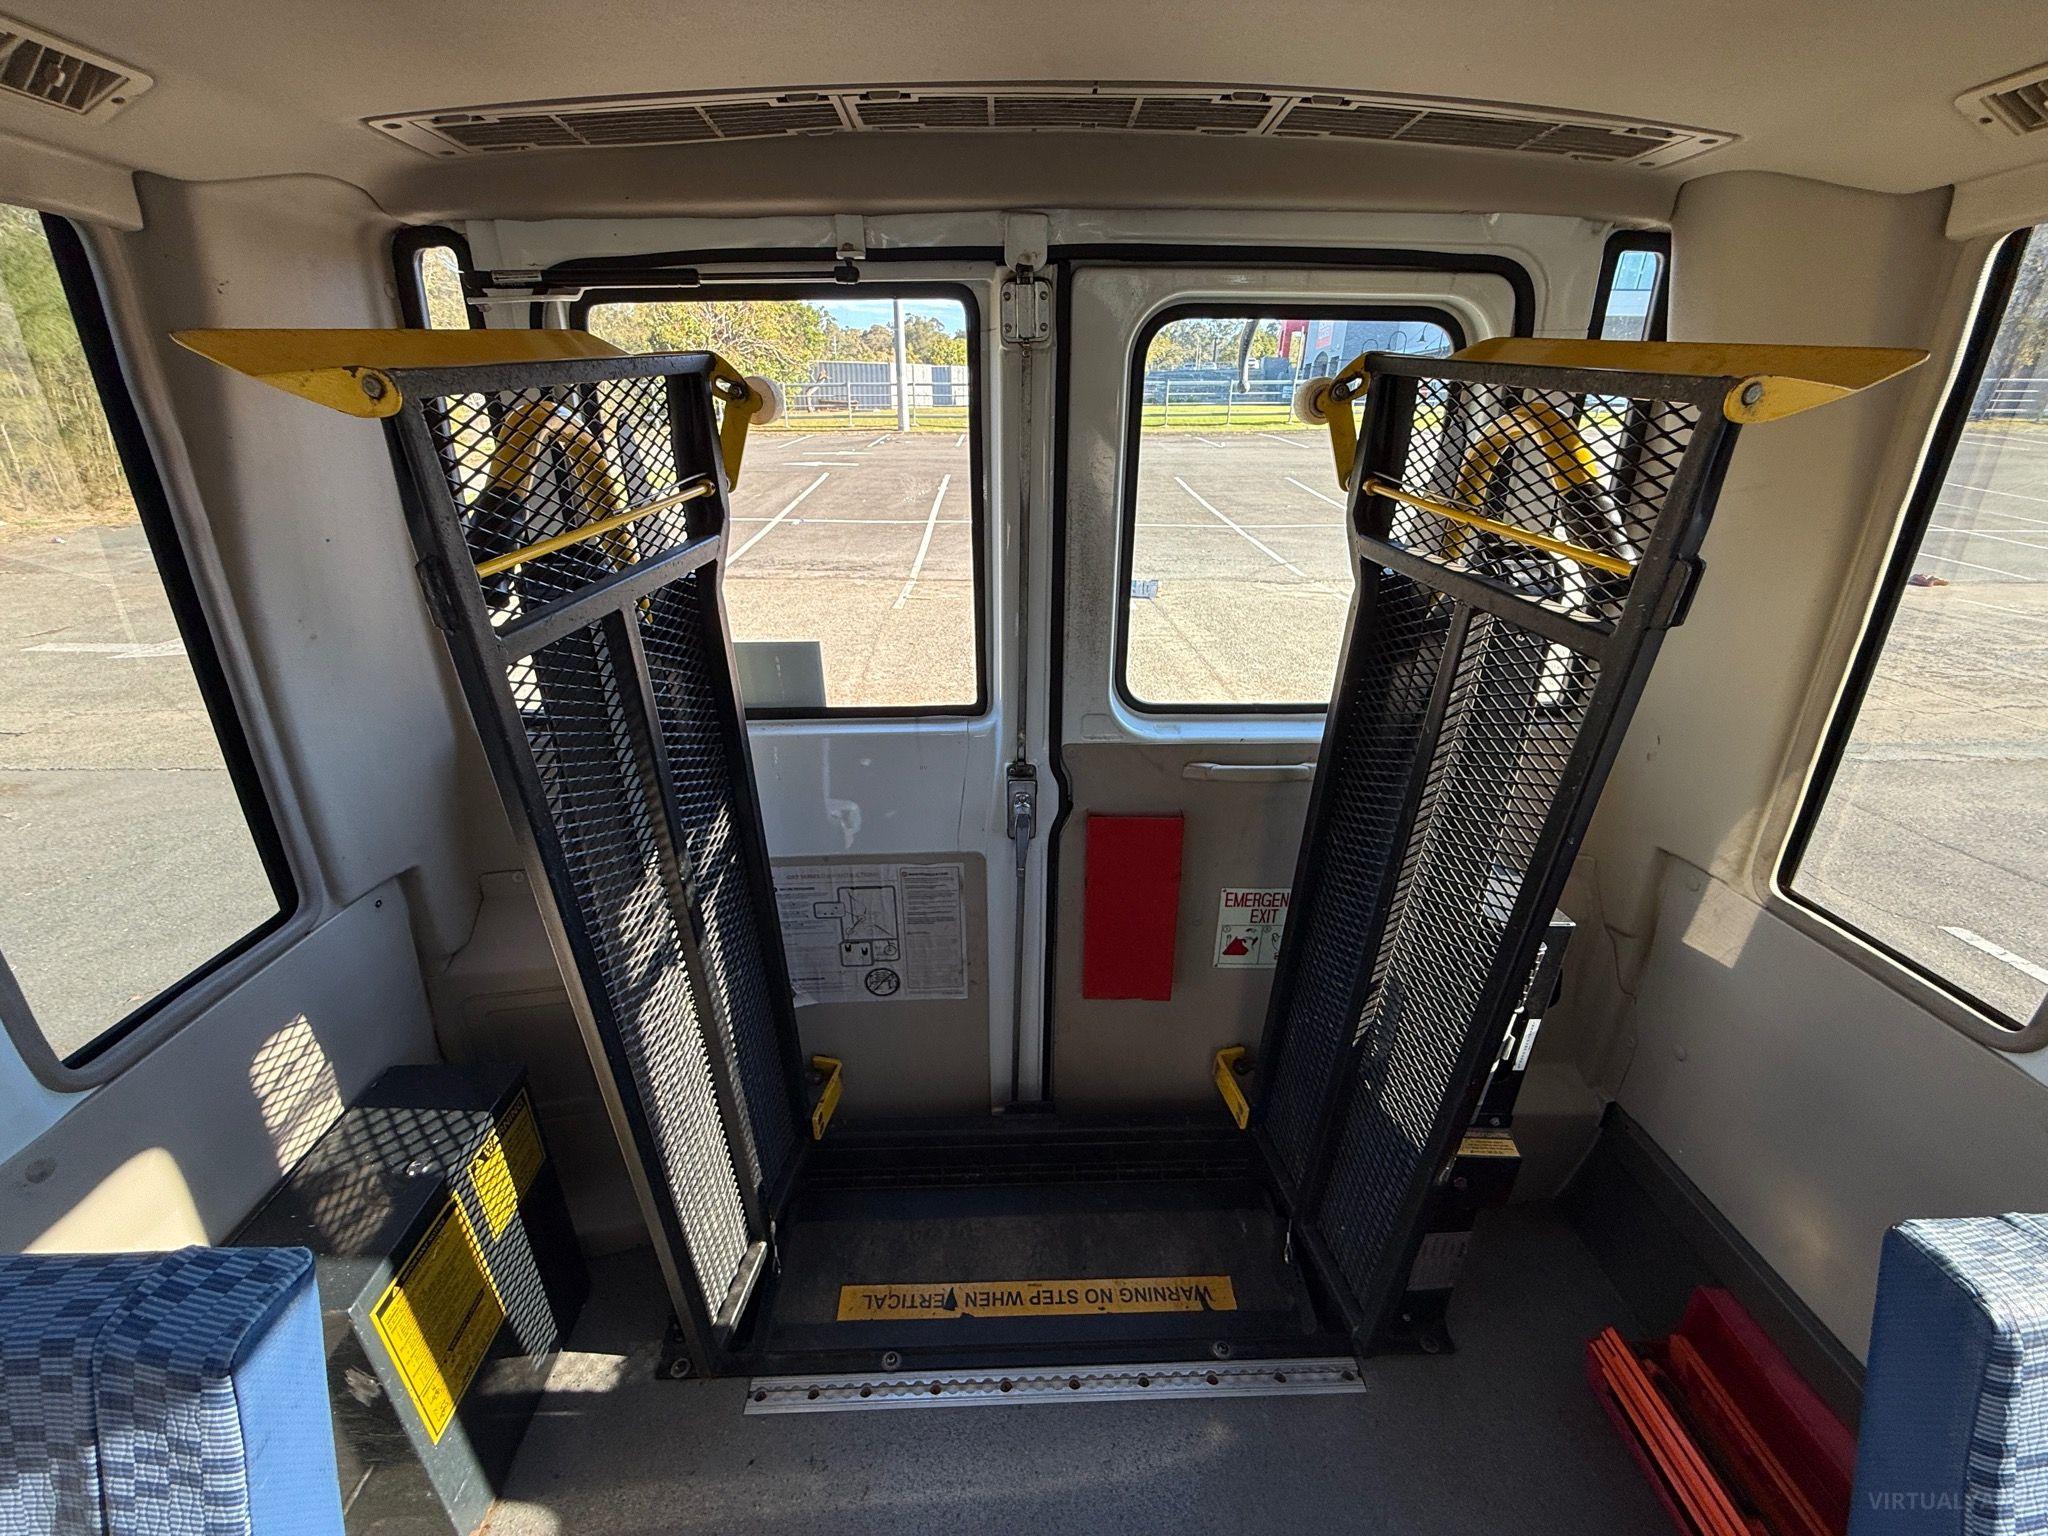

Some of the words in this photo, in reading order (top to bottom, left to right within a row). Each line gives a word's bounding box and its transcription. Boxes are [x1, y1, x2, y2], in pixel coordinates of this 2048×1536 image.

[1249, 908, 1280, 924] EXIT
[964, 1290, 1024, 1308] WHEN
[1029, 1289, 1079, 1306] STEP
[1084, 1288, 1113, 1304] NO
[1119, 1285, 1214, 1303] WARNING
